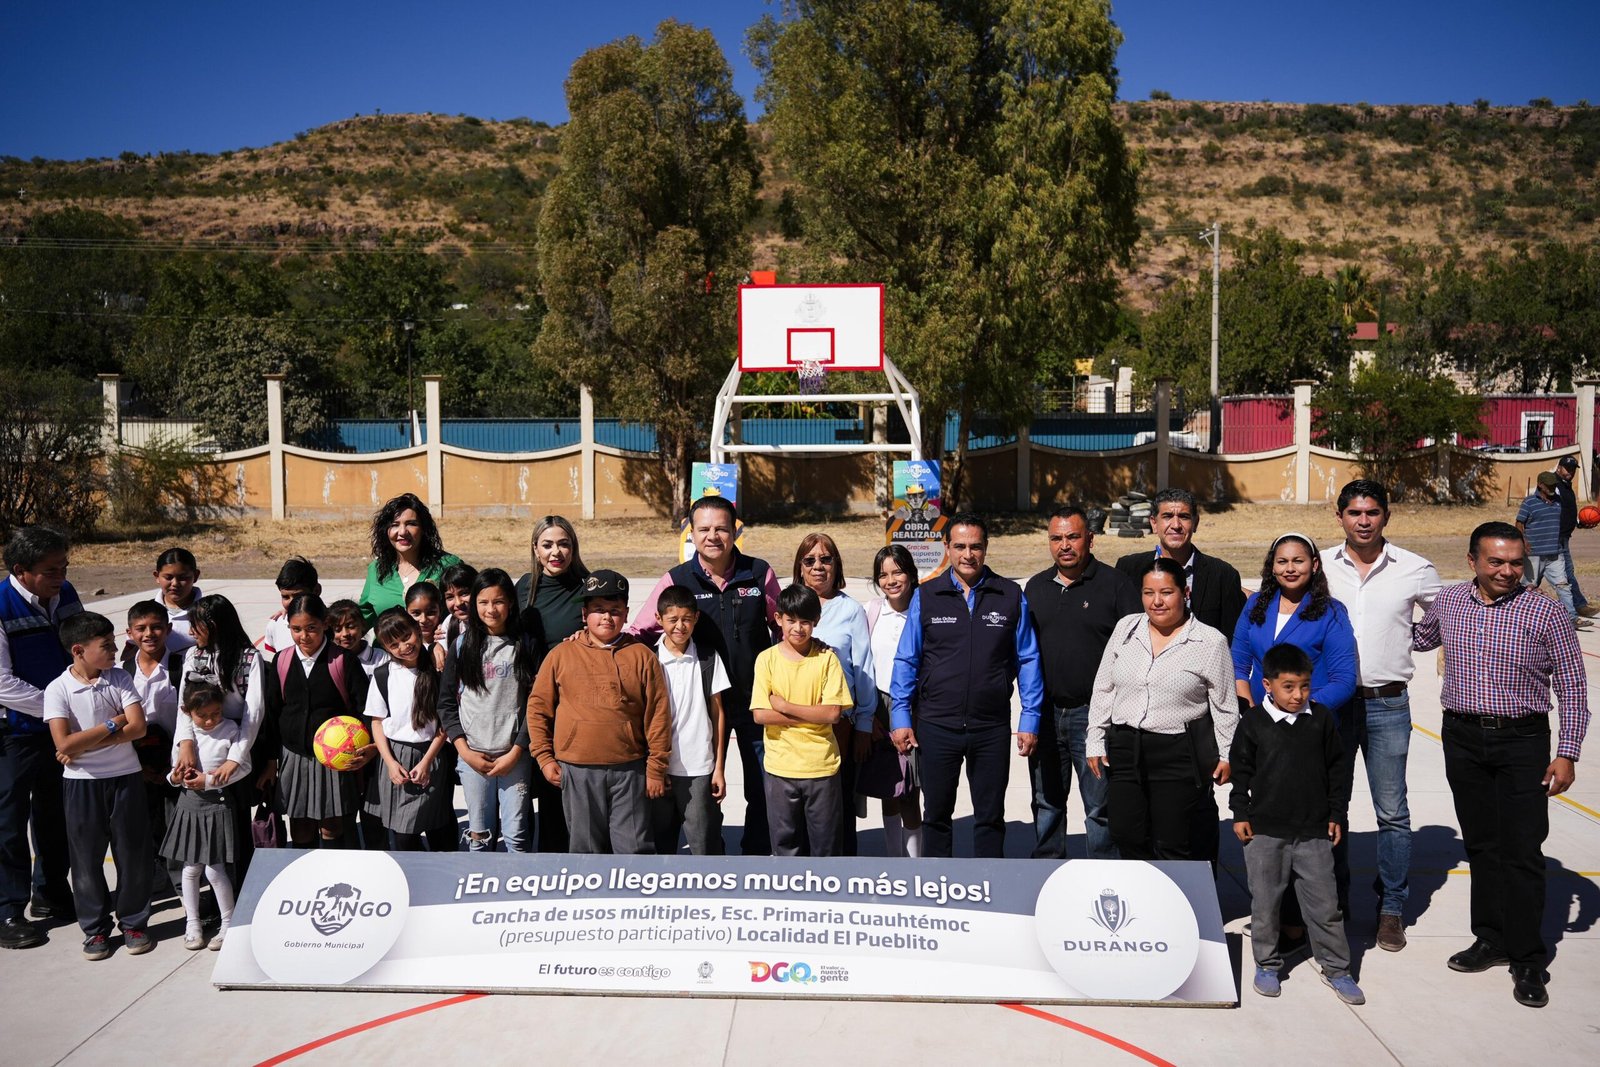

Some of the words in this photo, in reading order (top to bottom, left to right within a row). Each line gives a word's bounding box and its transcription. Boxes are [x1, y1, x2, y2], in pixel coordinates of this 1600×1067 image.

[904, 523, 930, 531] OBRA
[892, 531, 942, 539] REALIZADA
[455, 873, 500, 900] ¡En
[506, 868, 603, 896] equipo
[609, 868, 737, 895] llegamos
[744, 870, 841, 893] mucho
[848, 872, 908, 896] más
[914, 875, 991, 904] lejos!
[472, 908, 540, 925] Cancha
[545, 907, 568, 921] de
[573, 908, 616, 920] usos
[621, 905, 716, 922] múltiples,
[722, 906, 757, 920] Esc.
[763, 907, 844, 924] Primaria
[849, 911, 970, 932] Cuauhtémoc
[500, 927, 614, 947] (presupuesto
[618, 926, 732, 944] participativo)
[737, 927, 828, 944] Localidad
[834, 930, 850, 945] El
[856, 931, 939, 950] Pueblito
[1063, 940, 1169, 953] DURANGO
[539, 964, 551, 975] El
[554, 964, 597, 975] futuro
[598, 966, 615, 976] es
[617, 965, 671, 980] contigo
[820, 974, 849, 983] gente
